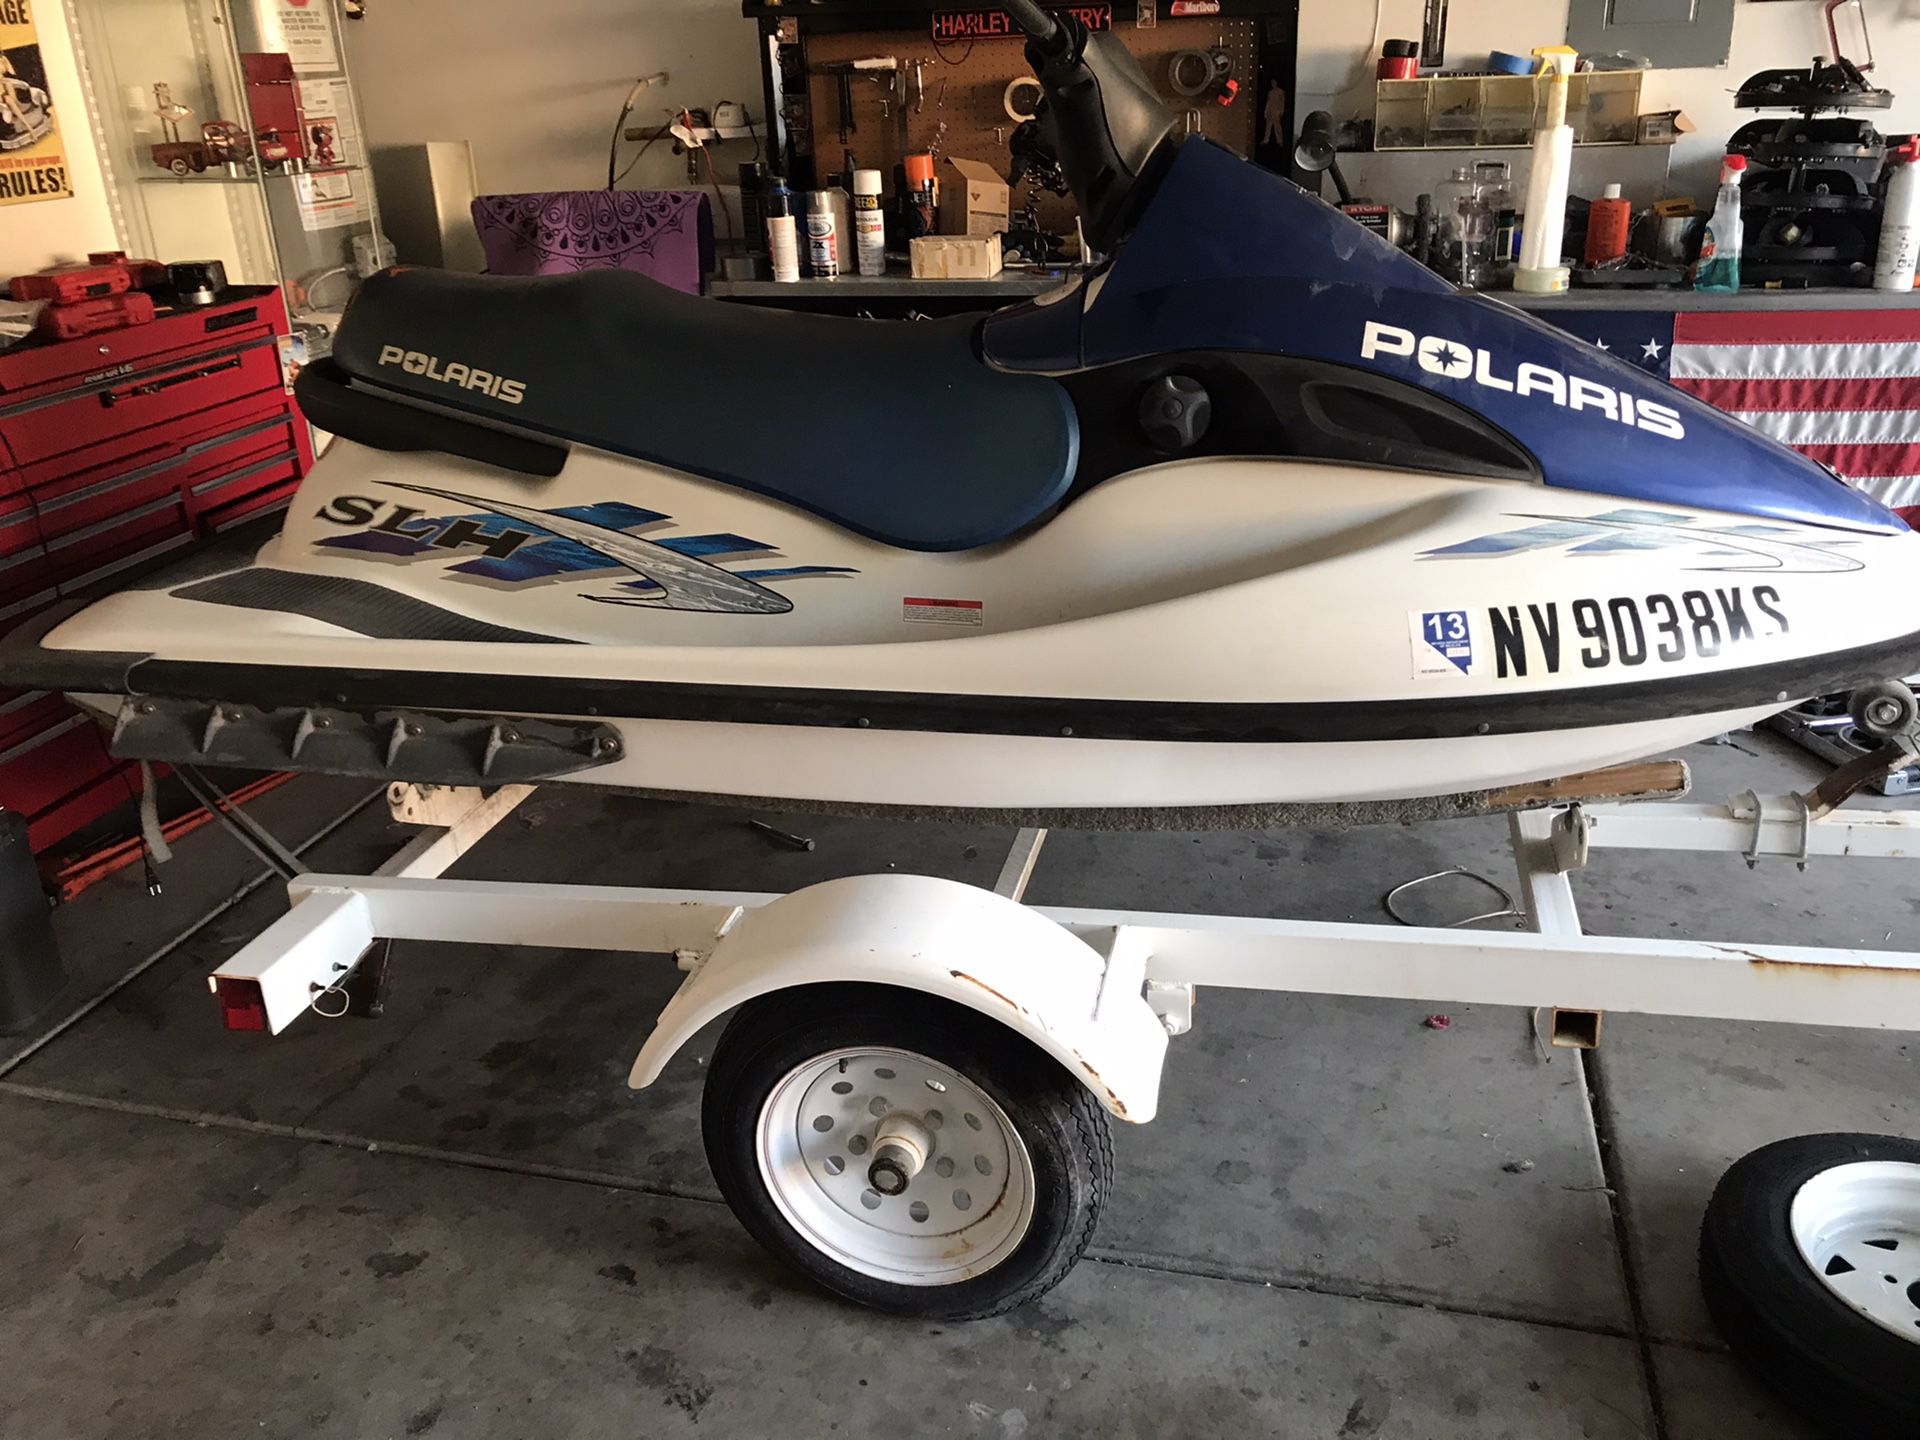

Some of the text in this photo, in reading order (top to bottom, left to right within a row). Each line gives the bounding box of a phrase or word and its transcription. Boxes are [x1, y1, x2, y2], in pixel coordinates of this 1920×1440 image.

[941, 13, 1010, 36] HARLEY
[0, 167, 67, 198] RULES!
[378, 345, 527, 404] POLARIS
[1361, 320, 1685, 440] POLARIS
[313, 496, 532, 560] SLH
[1428, 613, 1466, 640] 13
